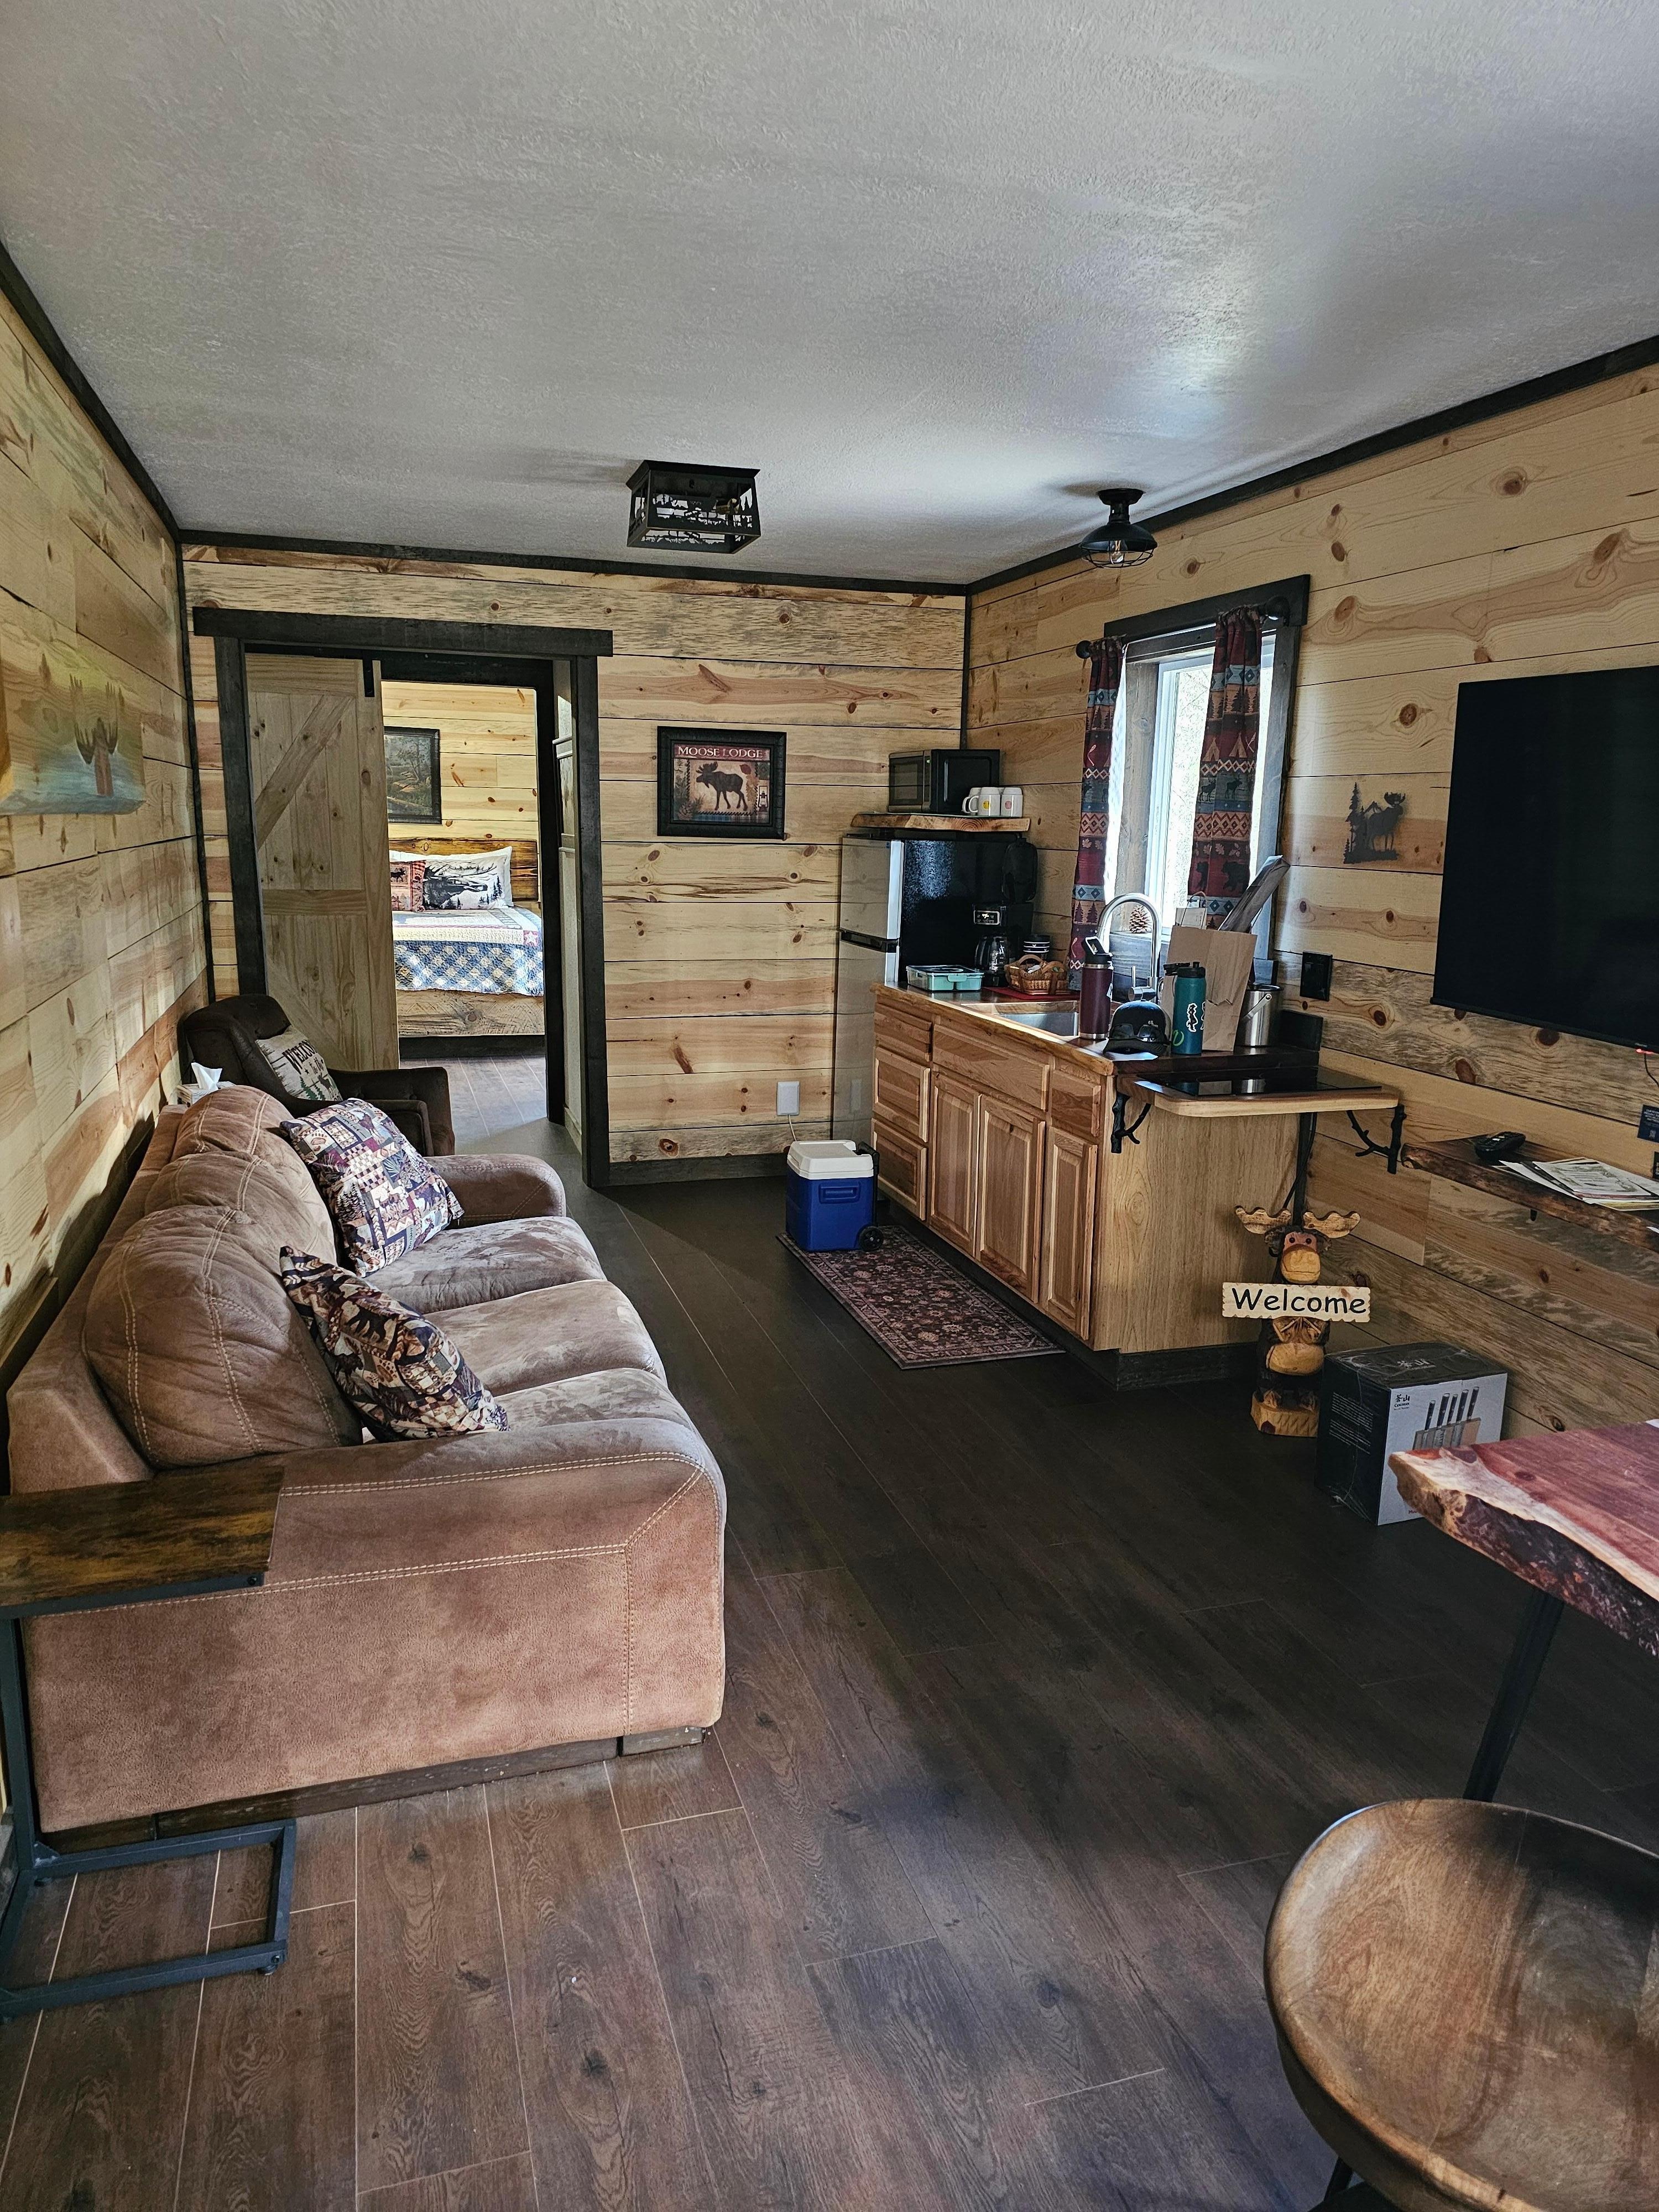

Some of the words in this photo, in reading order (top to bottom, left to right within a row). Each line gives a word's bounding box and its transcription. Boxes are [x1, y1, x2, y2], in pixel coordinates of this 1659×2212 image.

[678, 746, 719, 757] MOOSE
[722, 748, 764, 758] LODGE
[1232, 1287, 1366, 1314] Welcome
